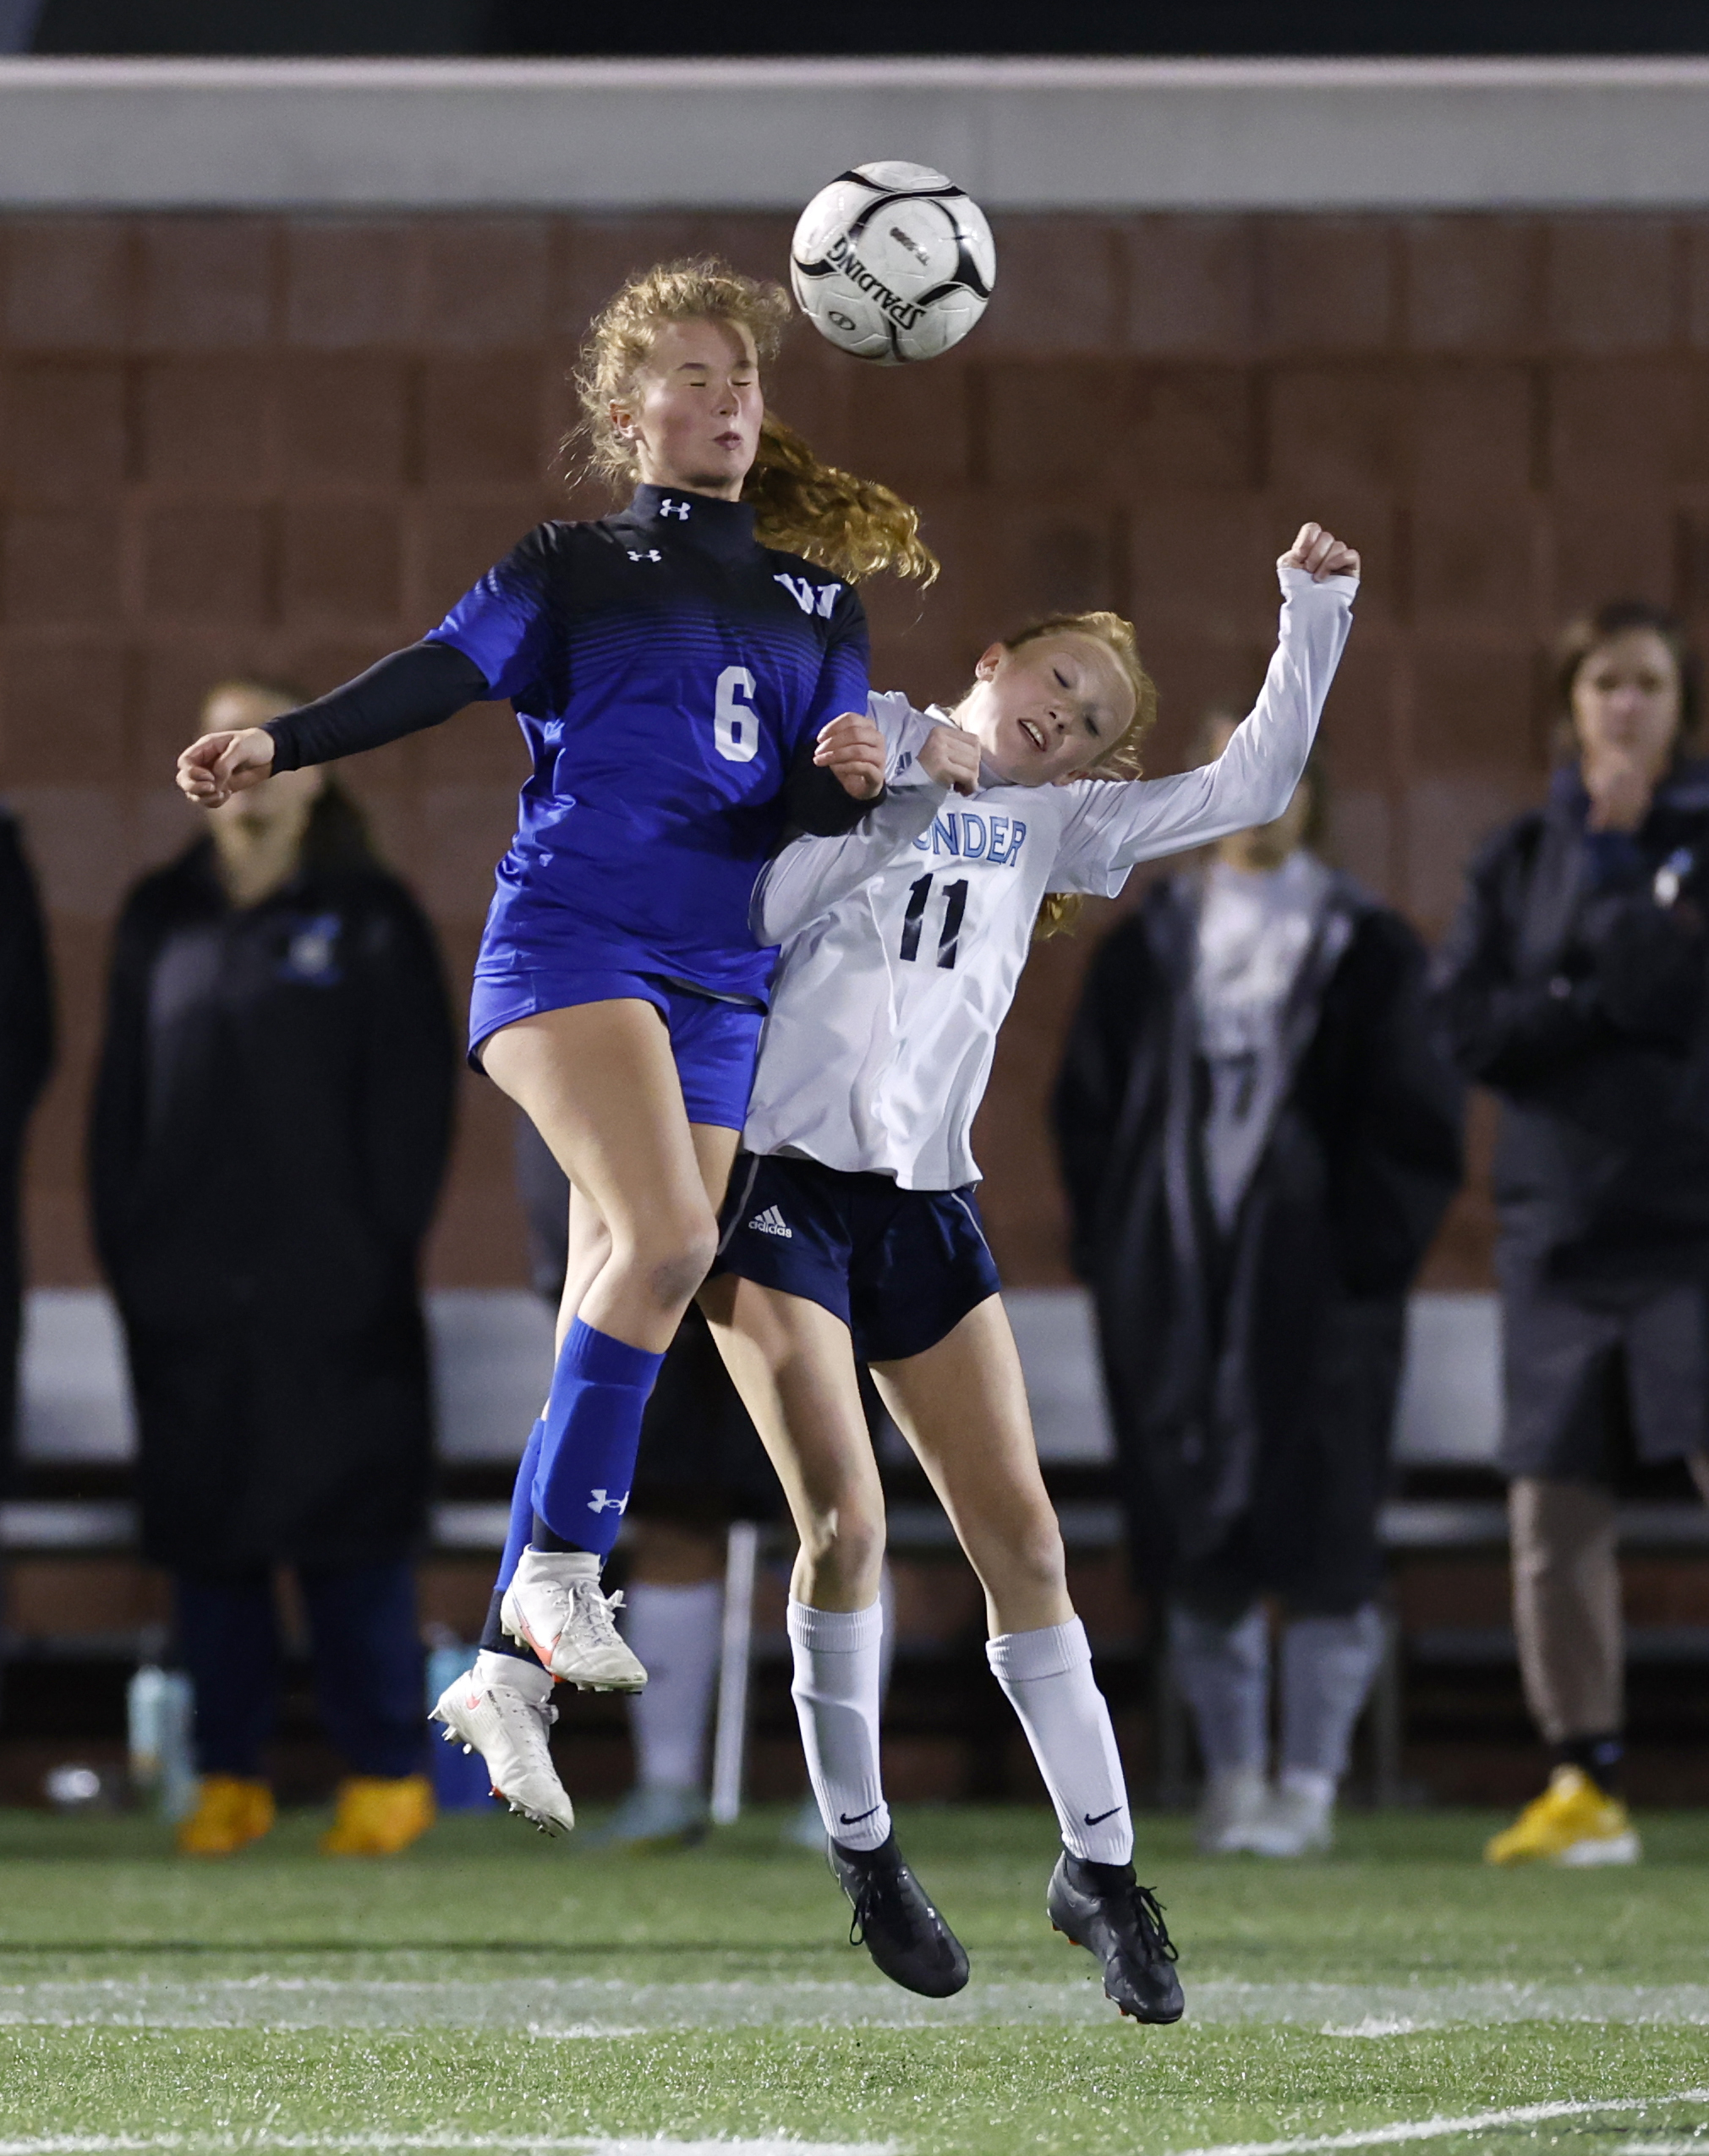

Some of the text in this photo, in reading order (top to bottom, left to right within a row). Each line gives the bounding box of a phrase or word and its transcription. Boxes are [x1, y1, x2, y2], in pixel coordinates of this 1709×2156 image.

[826, 233, 926, 330] SPALDING
[773, 573, 841, 619] W
[714, 665, 759, 762] 6
[900, 873, 968, 969] 11
[748, 1221, 792, 1238] adidas
